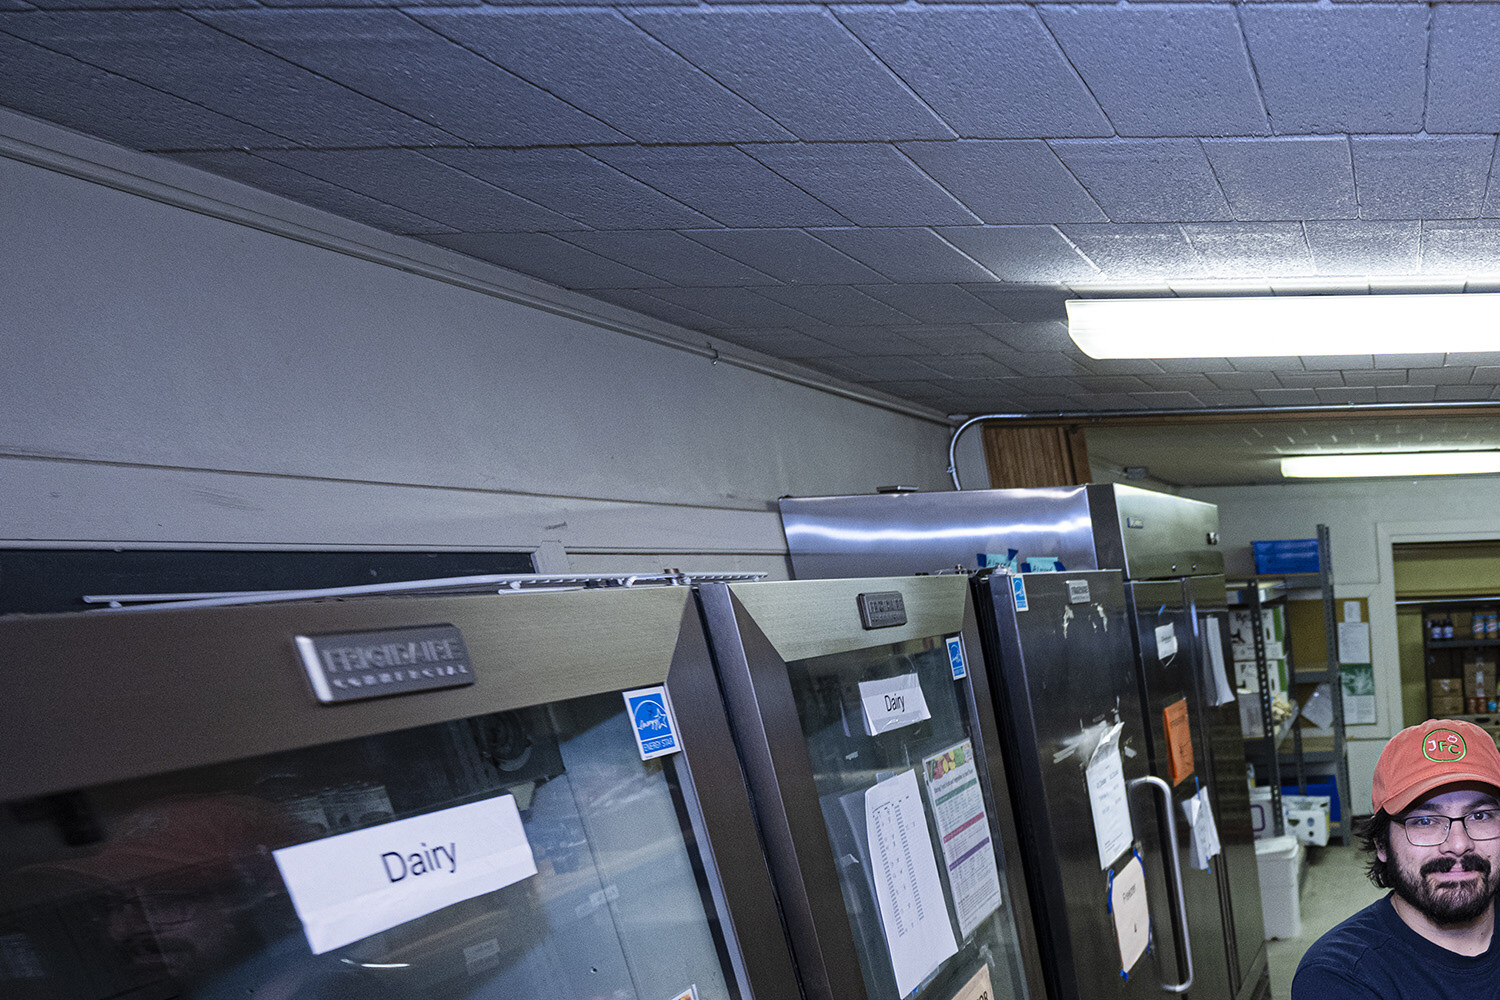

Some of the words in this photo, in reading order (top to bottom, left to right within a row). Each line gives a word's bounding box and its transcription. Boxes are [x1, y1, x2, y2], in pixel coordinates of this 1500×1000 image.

[322, 637, 465, 675] FRIGIDAIRE
[884, 692, 905, 713] Dairy
[659, 736, 675, 751] STAR
[1427, 739, 1462, 756] JFC
[380, 841, 458, 884] Dairy
